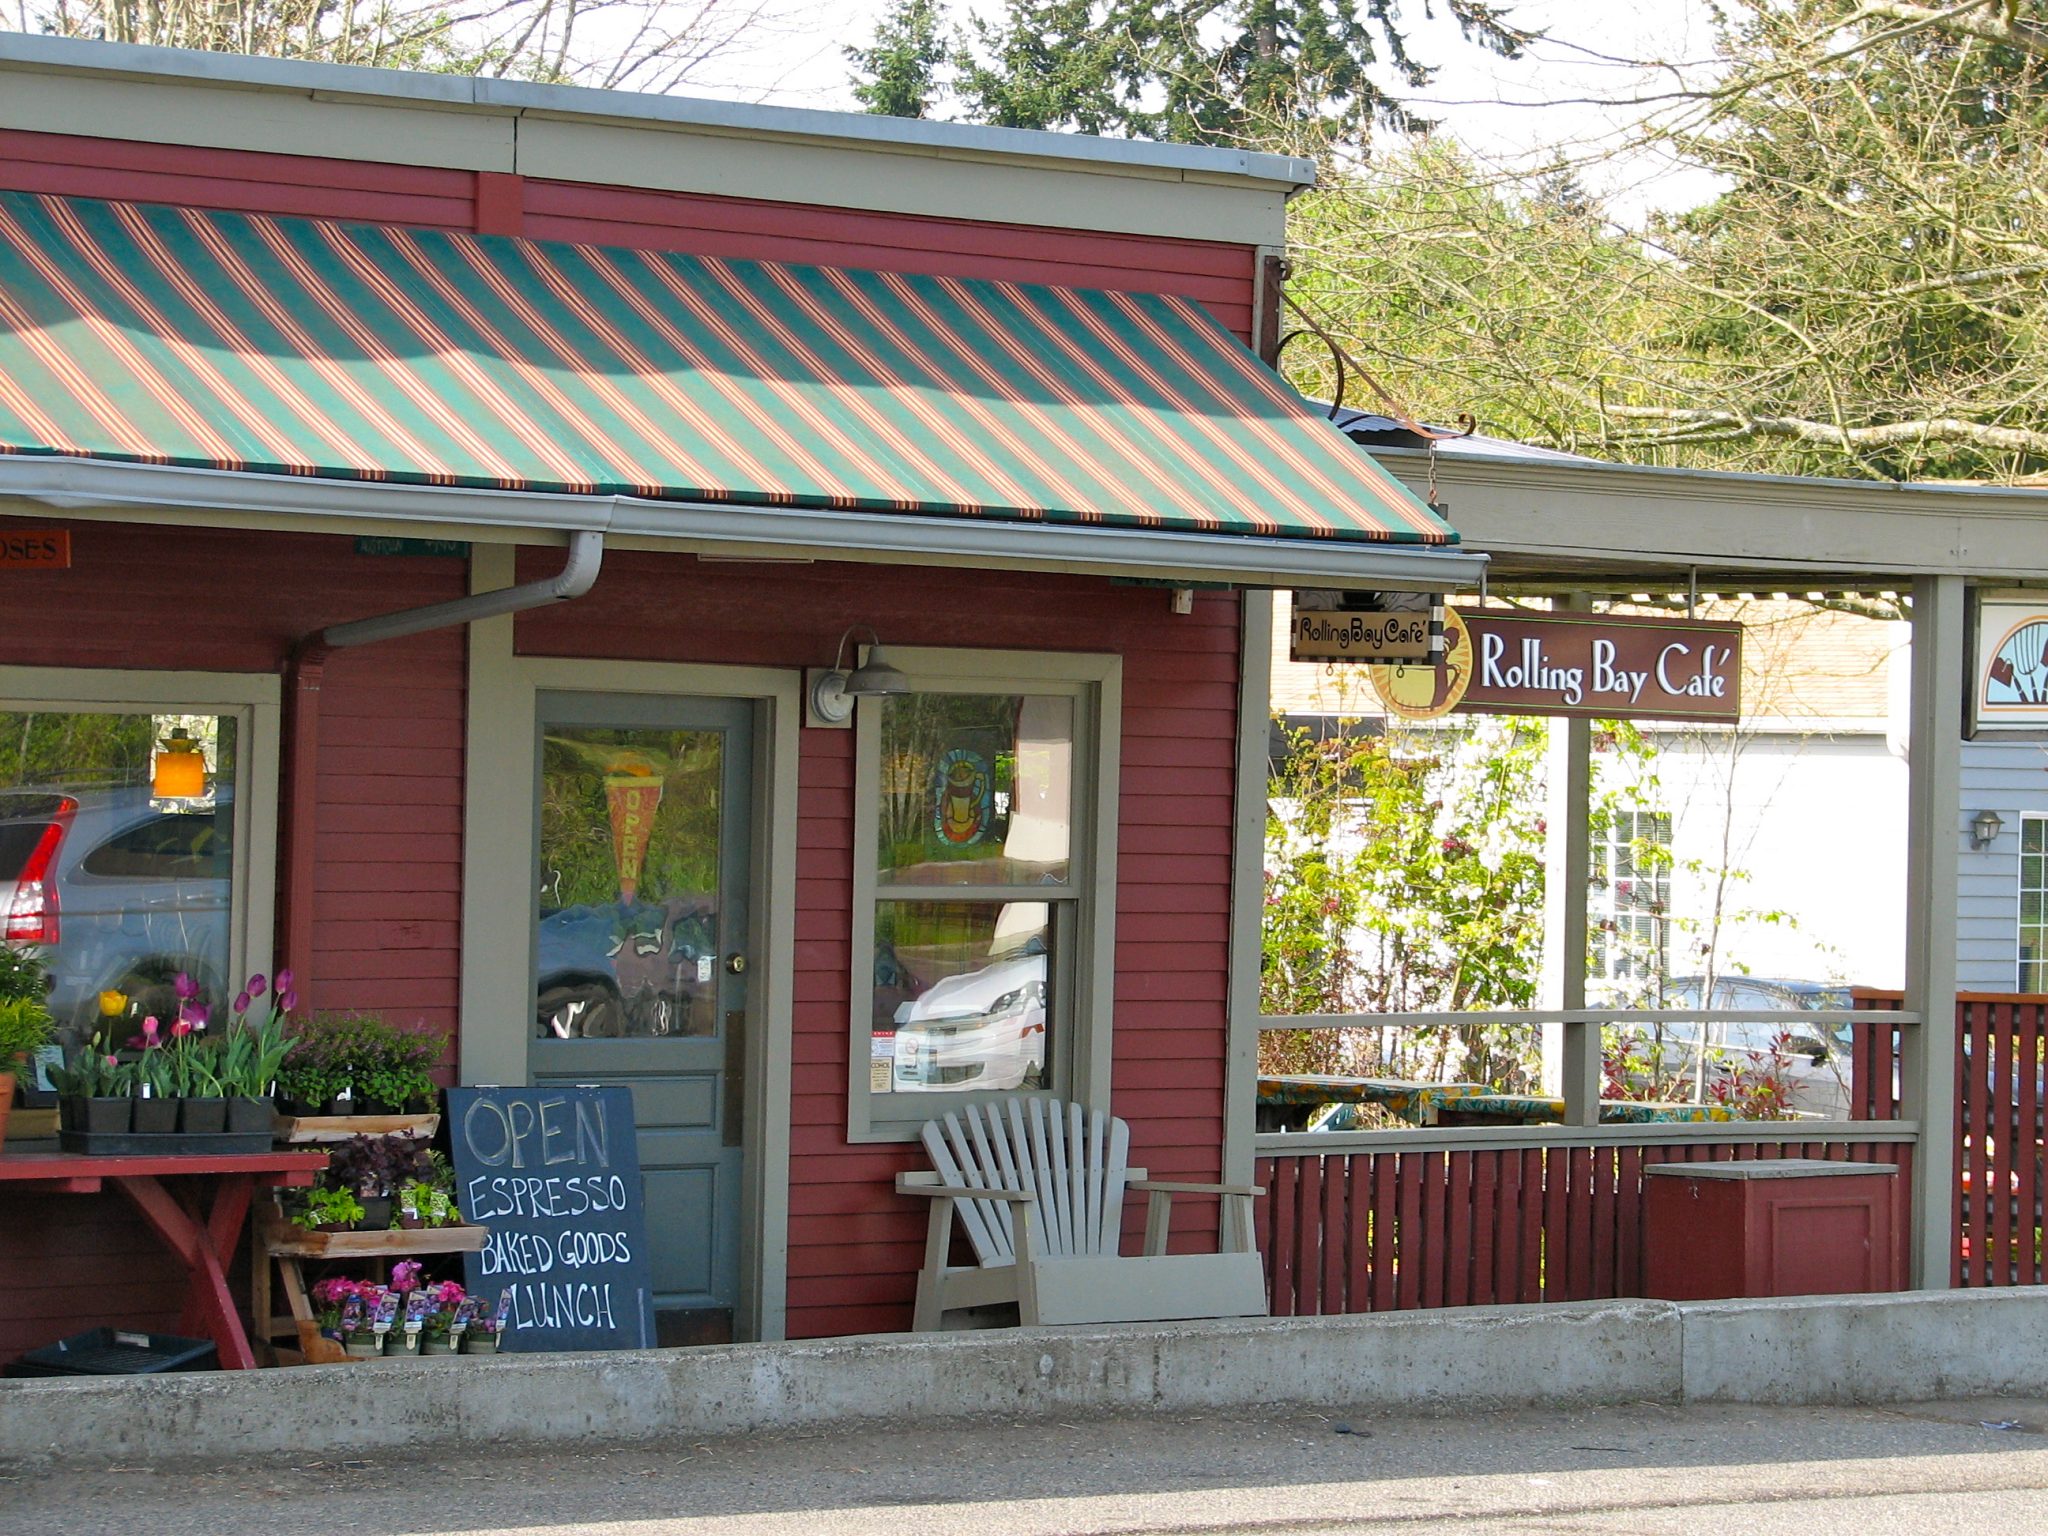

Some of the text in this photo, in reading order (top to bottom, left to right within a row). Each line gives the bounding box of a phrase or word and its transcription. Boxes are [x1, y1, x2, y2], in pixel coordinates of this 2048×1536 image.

[1480, 633, 1732, 705] Rolling Bay Café
[623, 790, 639, 879] OPEN
[464, 1096, 610, 1169] OPEN
[468, 1175, 627, 1221] ESPRESSO
[481, 1229, 632, 1276] BAKED GOODS
[510, 1281, 617, 1331] LUNCH
